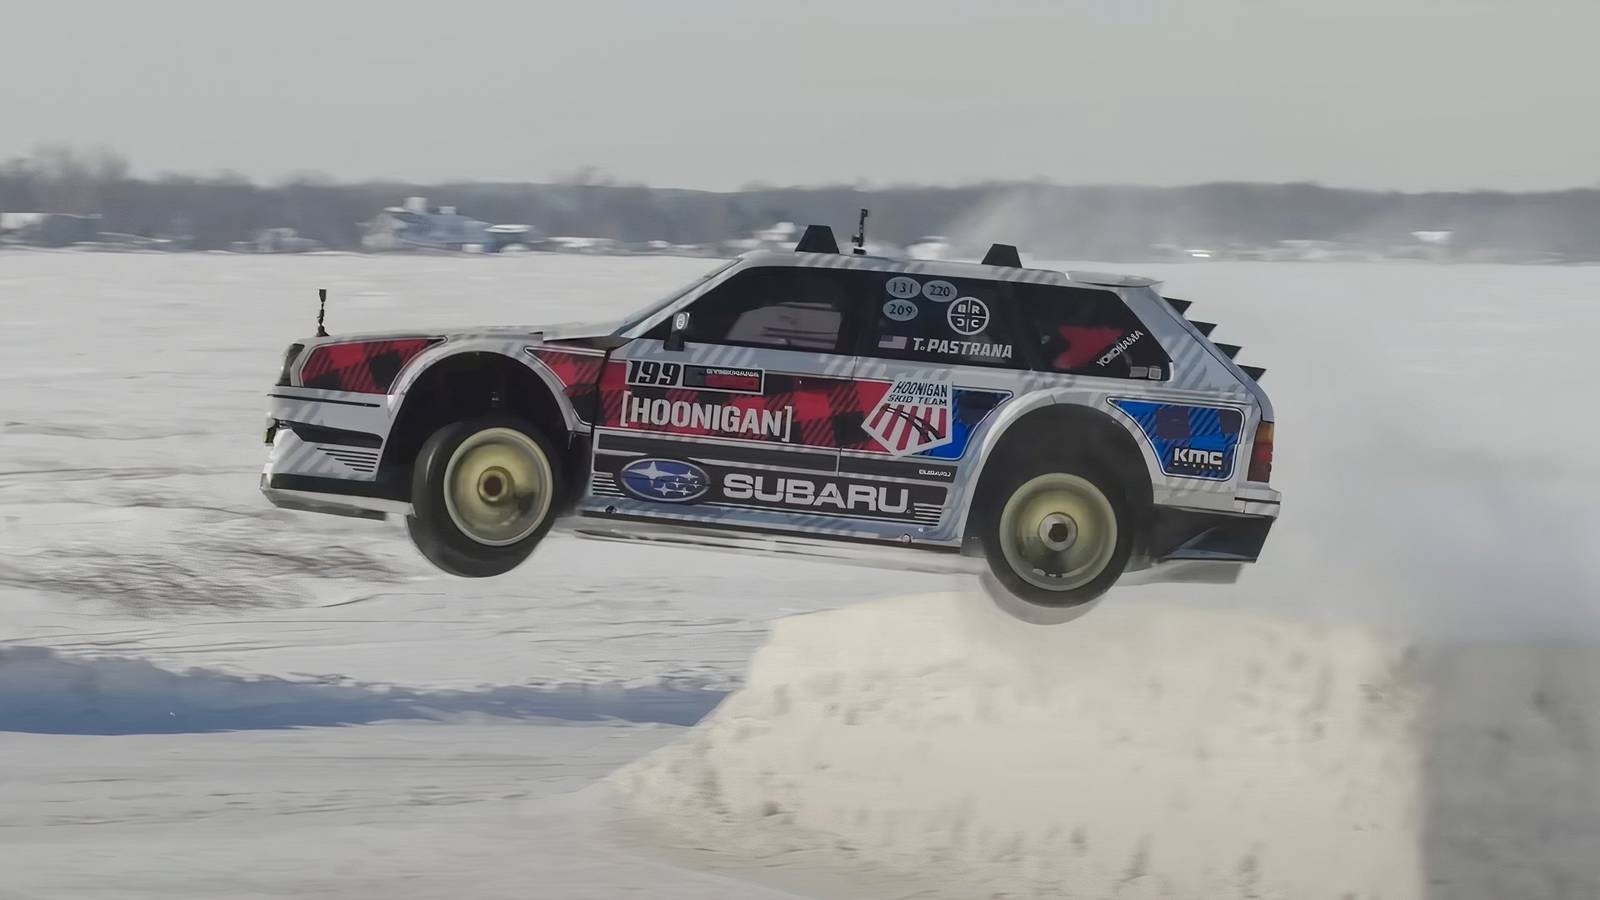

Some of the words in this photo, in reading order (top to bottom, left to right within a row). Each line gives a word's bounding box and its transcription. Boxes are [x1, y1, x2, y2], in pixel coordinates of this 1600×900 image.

[893, 281, 914, 294] 131
[929, 284, 951, 297] 220
[889, 303, 913, 316] 209
[628, 360, 681, 386] 199
[892, 381, 948, 397] HOONIGAN
[887, 394, 914, 404] SKID
[918, 396, 947, 406] TEAM
[722, 473, 909, 513] SUBARU
